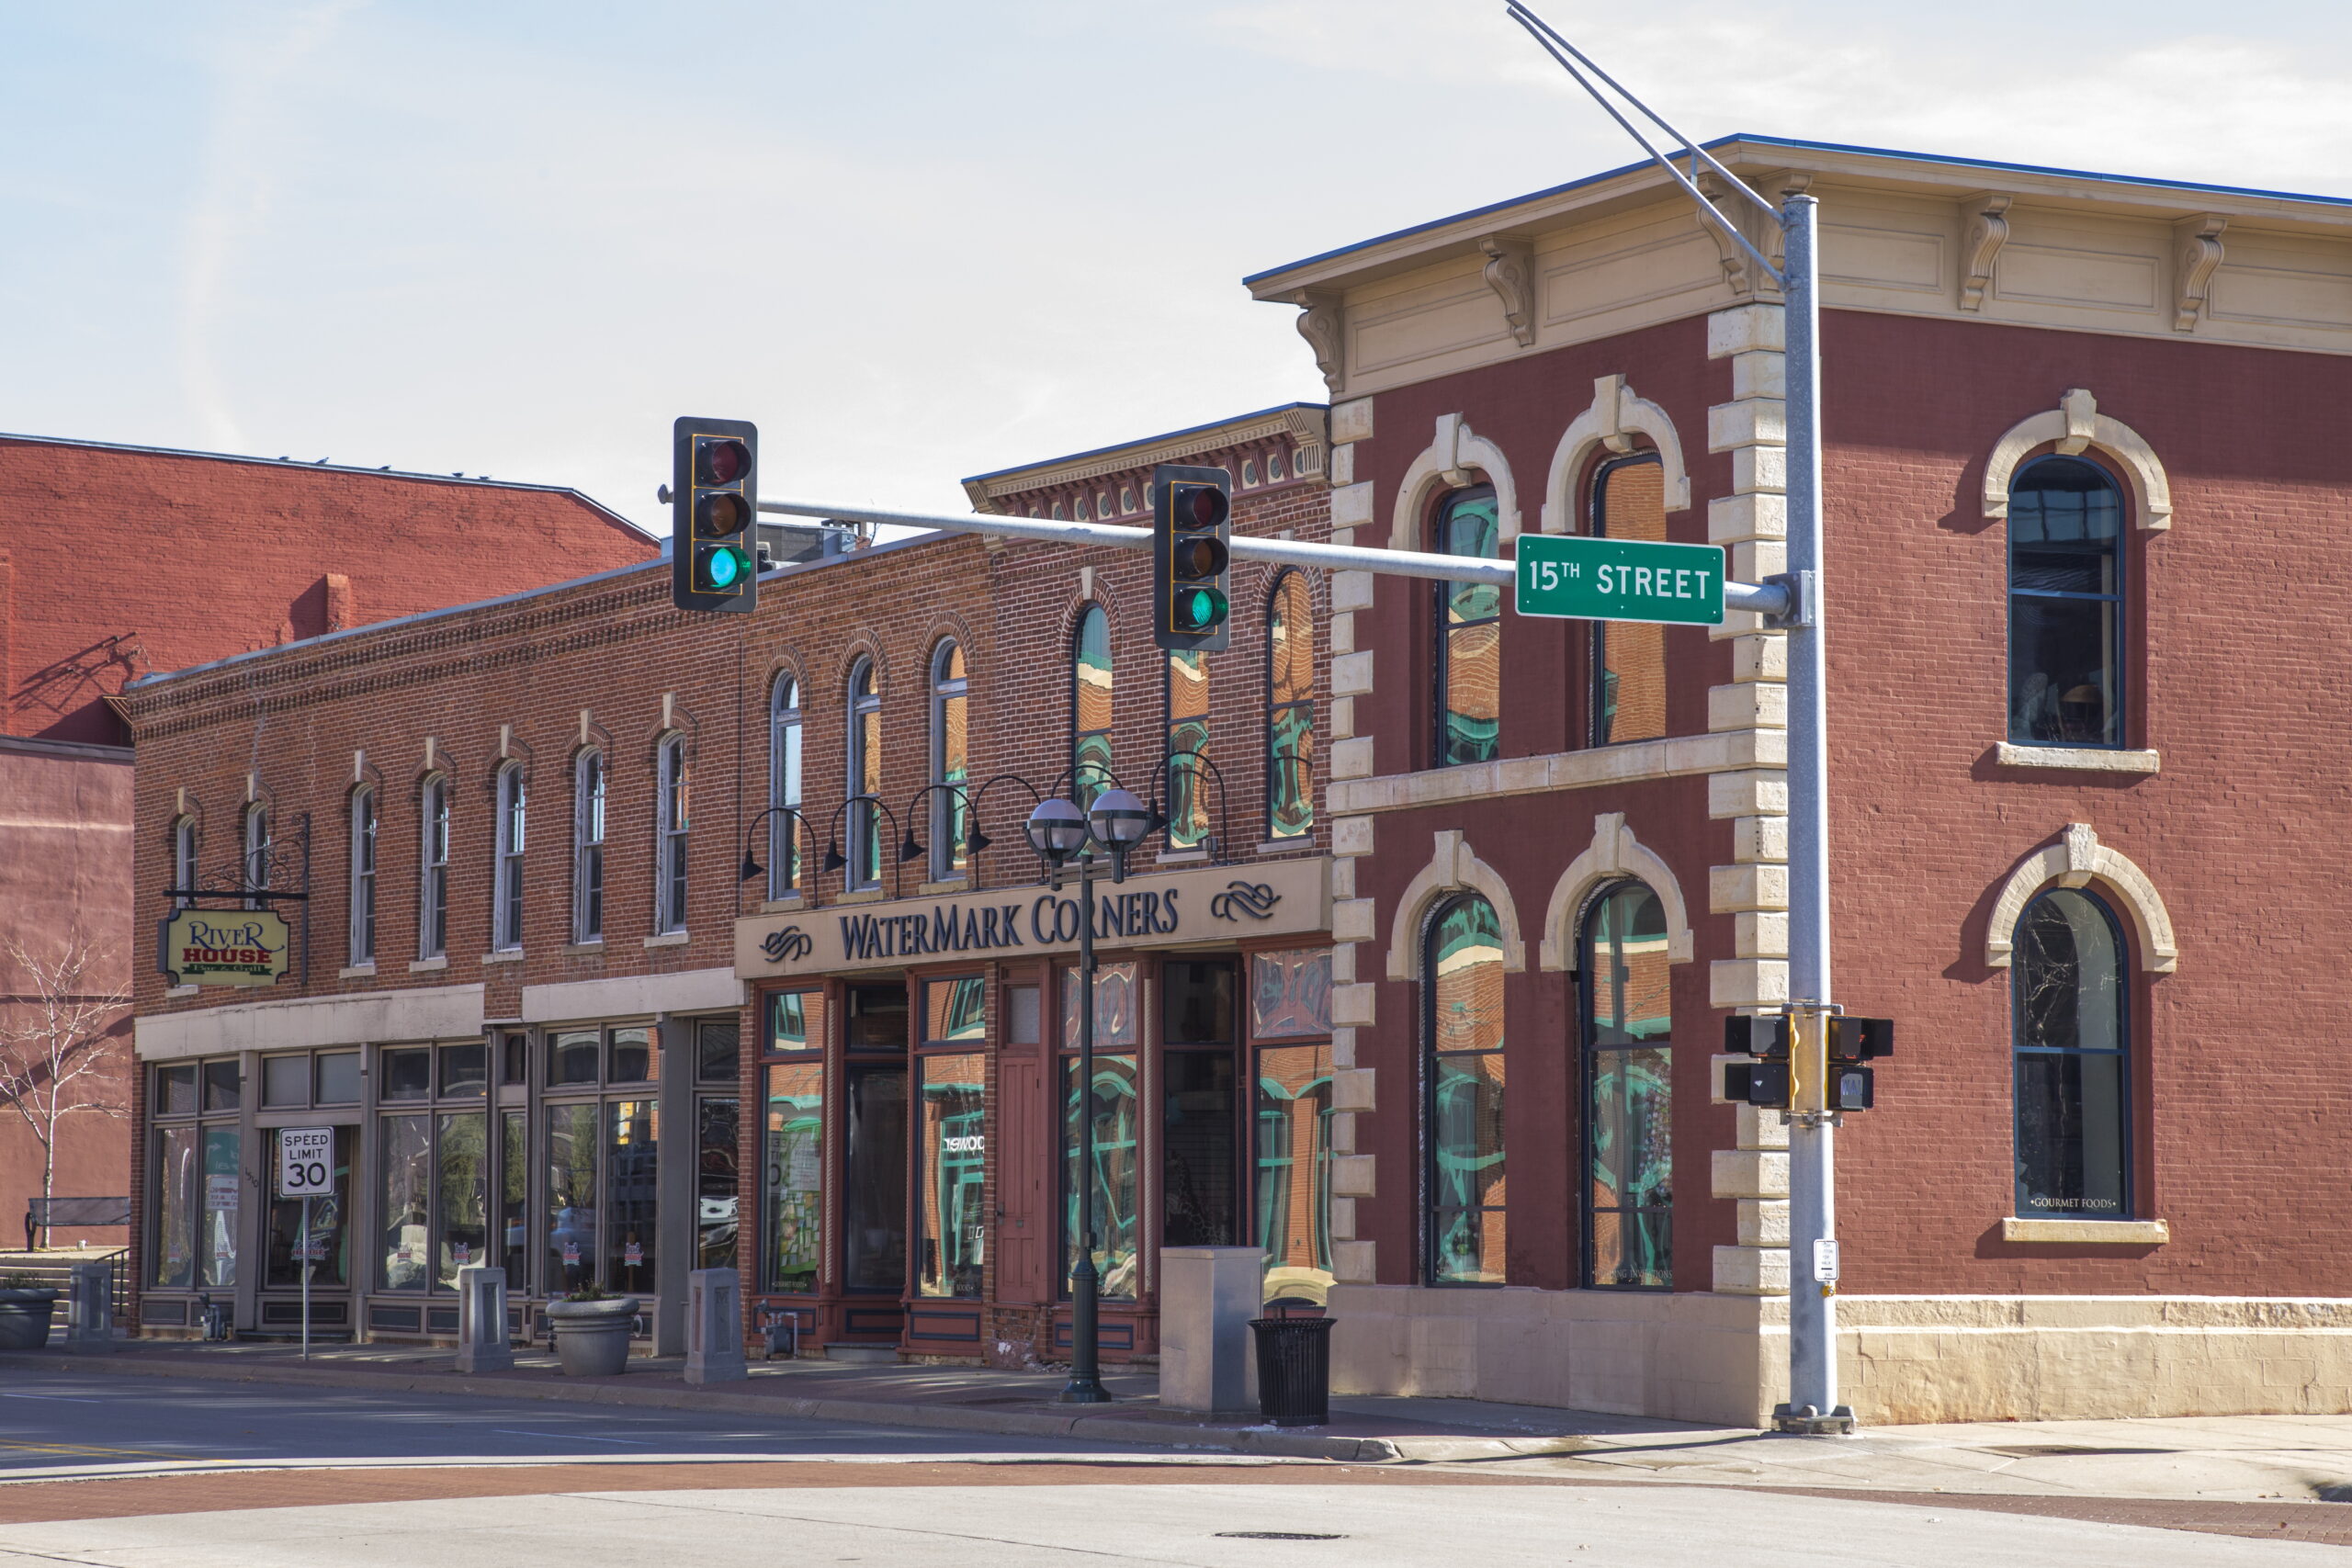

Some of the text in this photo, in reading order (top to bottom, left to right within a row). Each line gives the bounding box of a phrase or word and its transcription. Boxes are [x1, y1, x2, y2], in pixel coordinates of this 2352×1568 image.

[1529, 560, 1711, 600] 15TH STREET
[183, 947, 273, 964] HOUSE
[285, 1134, 328, 1146] SPEED
[289, 1148, 323, 1160] LIMIT
[288, 1162, 326, 1188] 30
